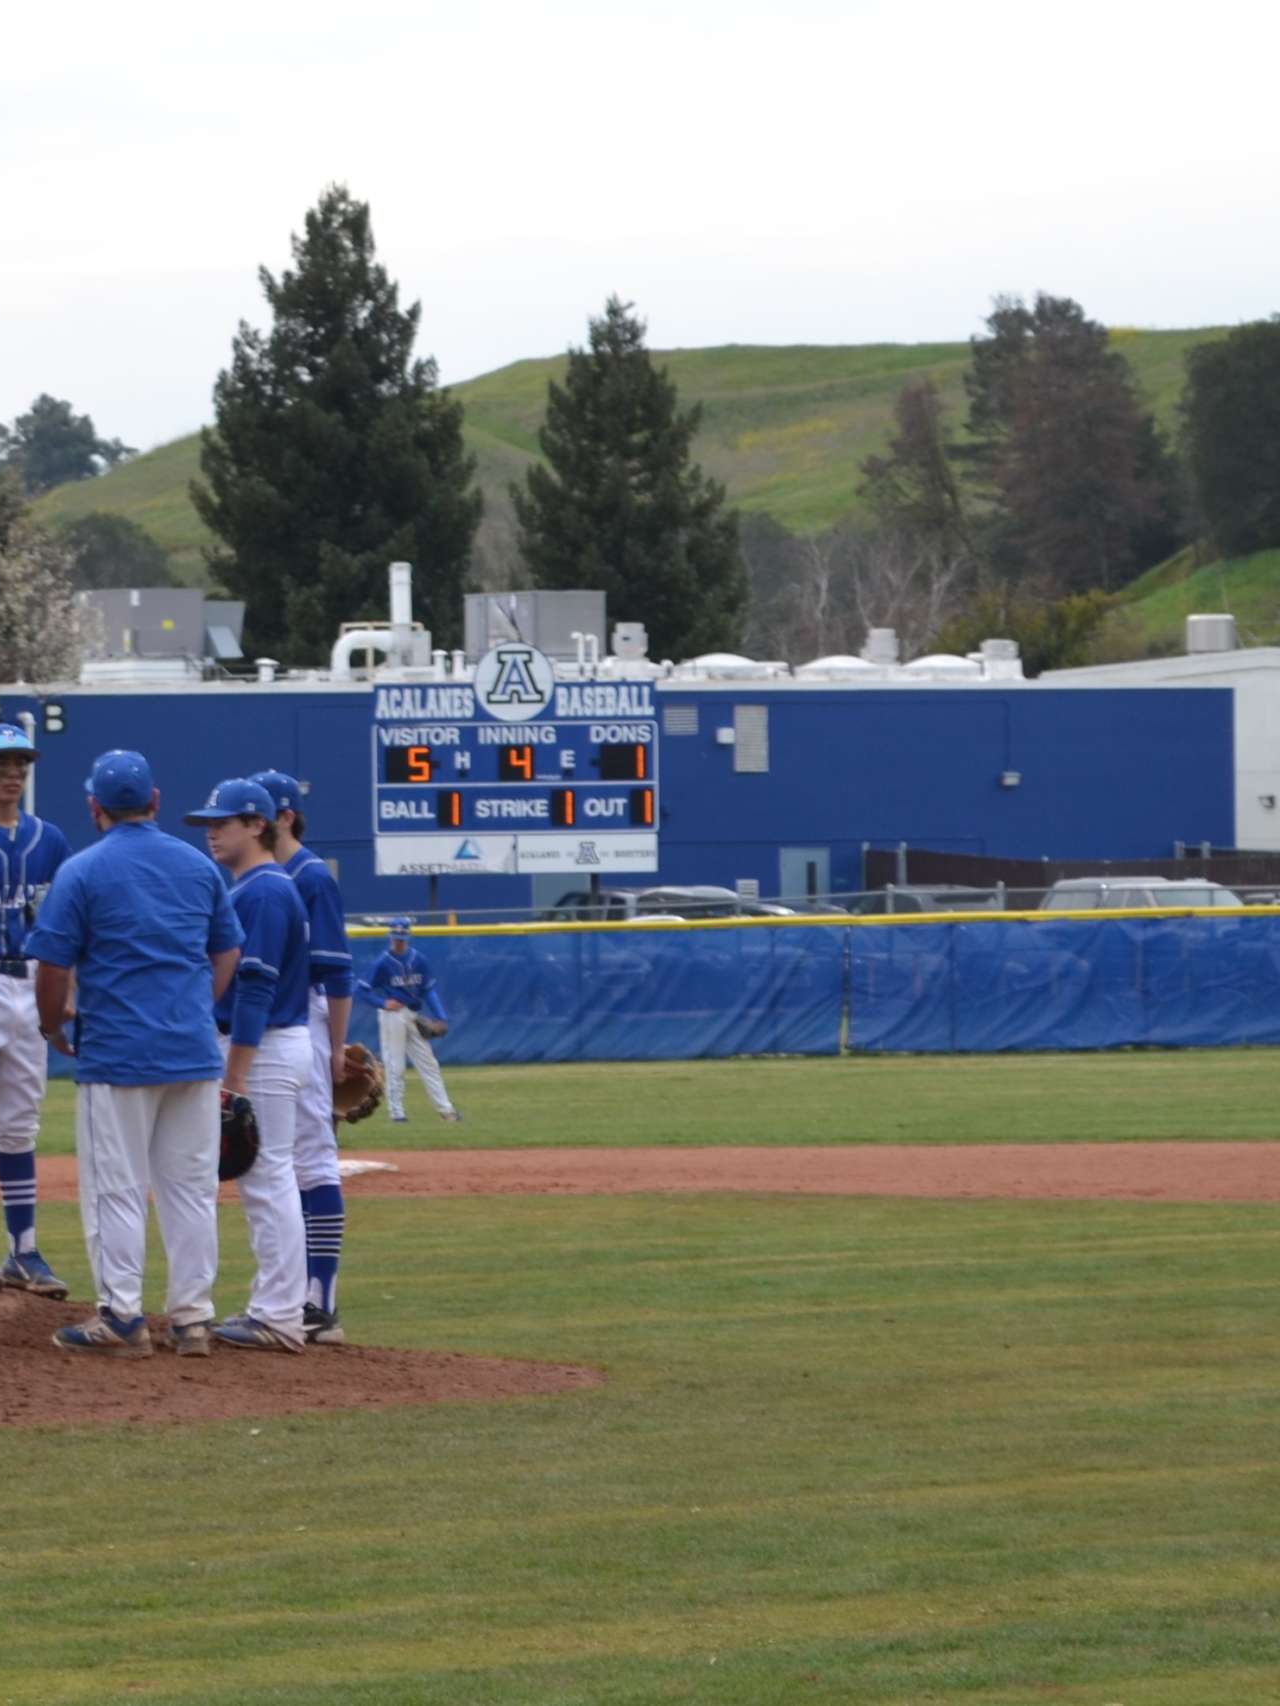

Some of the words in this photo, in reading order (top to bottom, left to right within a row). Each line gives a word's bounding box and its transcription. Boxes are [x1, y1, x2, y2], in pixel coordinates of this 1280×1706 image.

[486, 650, 544, 704] A
[375, 687, 475, 719] ACALANES
[555, 685, 655, 717] BASEBALL
[380, 727, 461, 746] VISITOR
[477, 726, 558, 745] INNING
[590, 725, 652, 744] DONS
[407, 746, 431, 782] 5
[454, 750, 471, 770] H
[509, 746, 532, 780] 4
[560, 749, 576, 769] E
[635, 744, 646, 779] 1
[380, 800, 436, 819] BALL
[451, 791, 461, 827] 1
[475, 798, 549, 818] STRIKE
[564, 789, 574, 826] 1
[583, 798, 628, 817] OUT
[644, 789, 654, 824] 1
